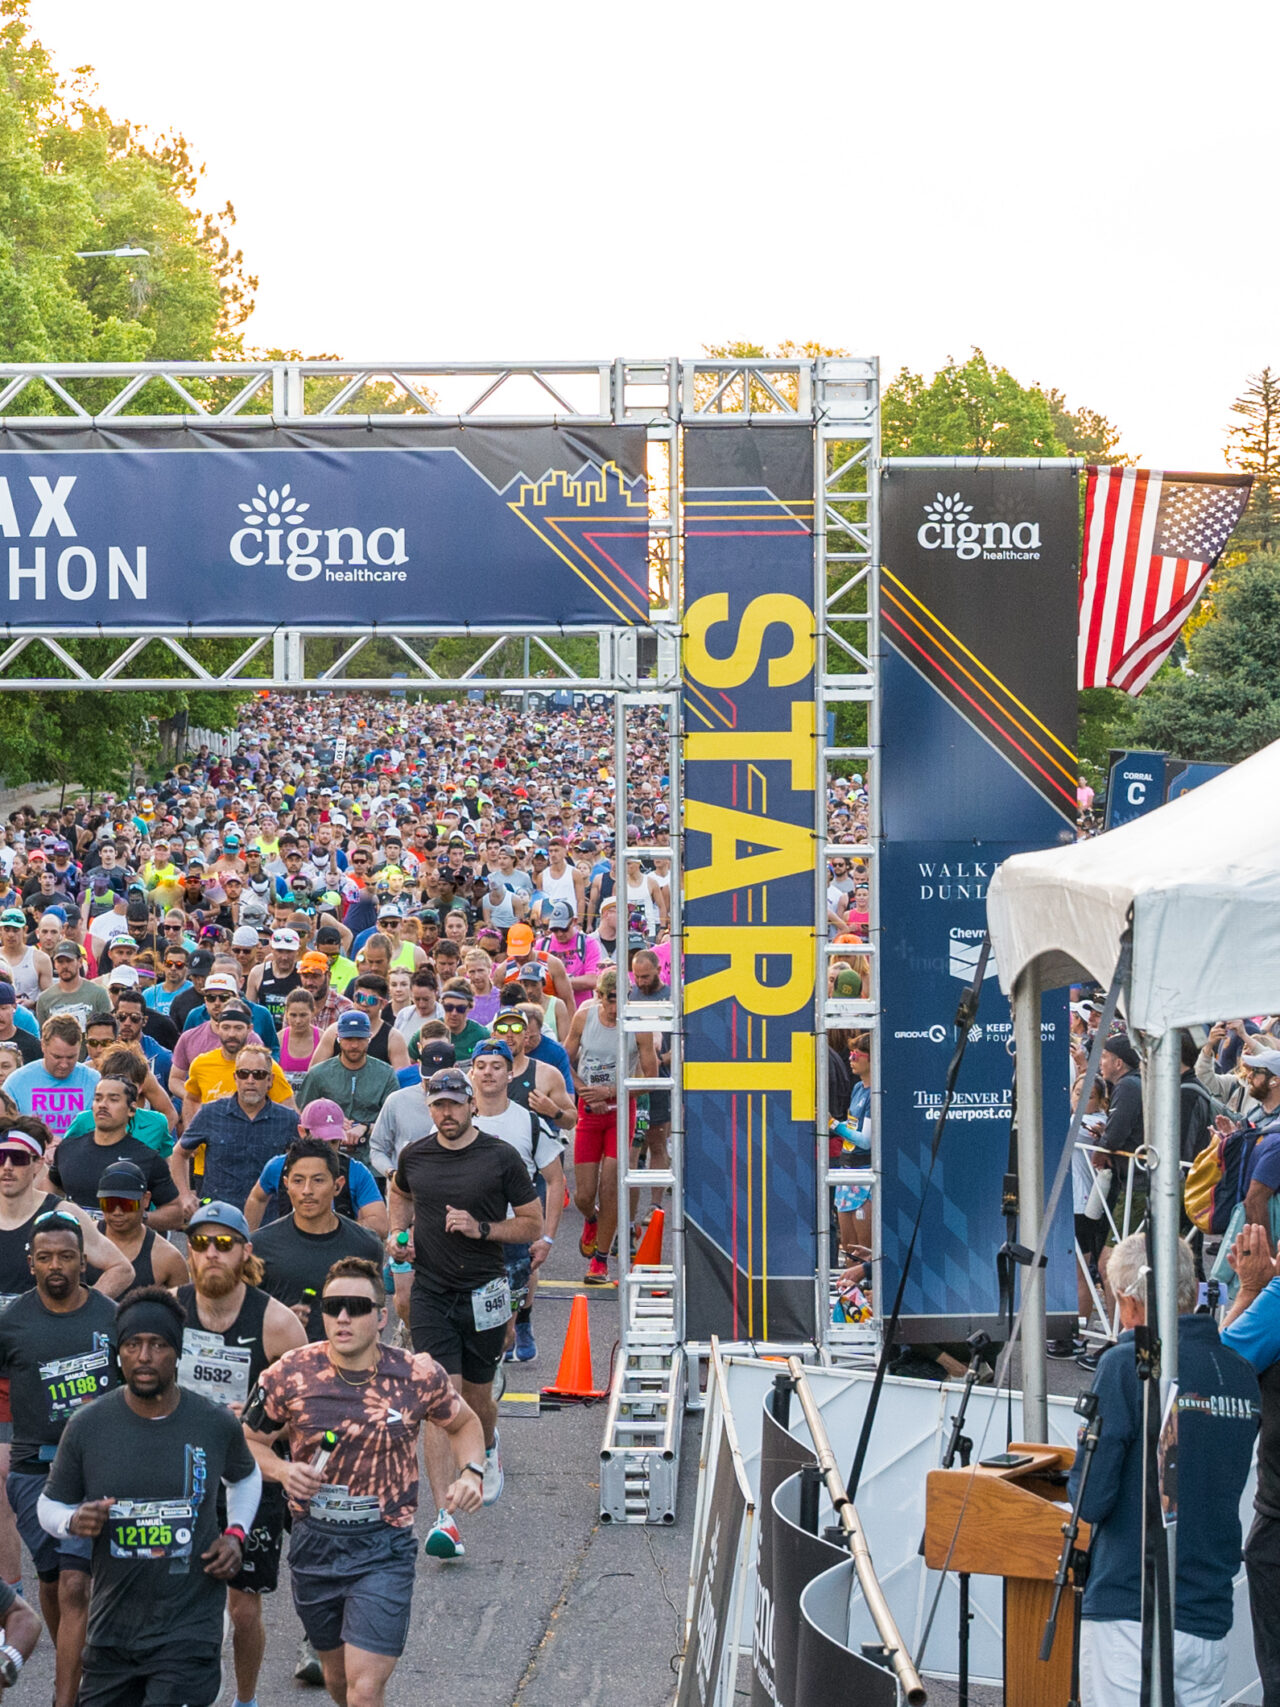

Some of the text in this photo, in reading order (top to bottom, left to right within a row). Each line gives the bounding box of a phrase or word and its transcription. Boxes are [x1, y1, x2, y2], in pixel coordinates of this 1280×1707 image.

[917, 521, 1042, 560] cigna
[229, 524, 409, 582] cigna
[983, 550, 1041, 561] healthcare
[325, 568, 408, 583] healthcare
[1123, 771, 1153, 781] CORRAL
[1127, 782, 1146, 805] C
[683, 592, 816, 1121] START
[920, 885, 987, 900] DUNL
[949, 927, 987, 939] Chevr
[986, 1023, 1012, 1032] KEEP
[32, 1093, 84, 1111] RUN
[193, 1364, 232, 1385] 9532
[48, 1375, 97, 1401] 11198
[1178, 1398, 1210, 1409] DENVER
[116, 1525, 172, 1546] 12125
